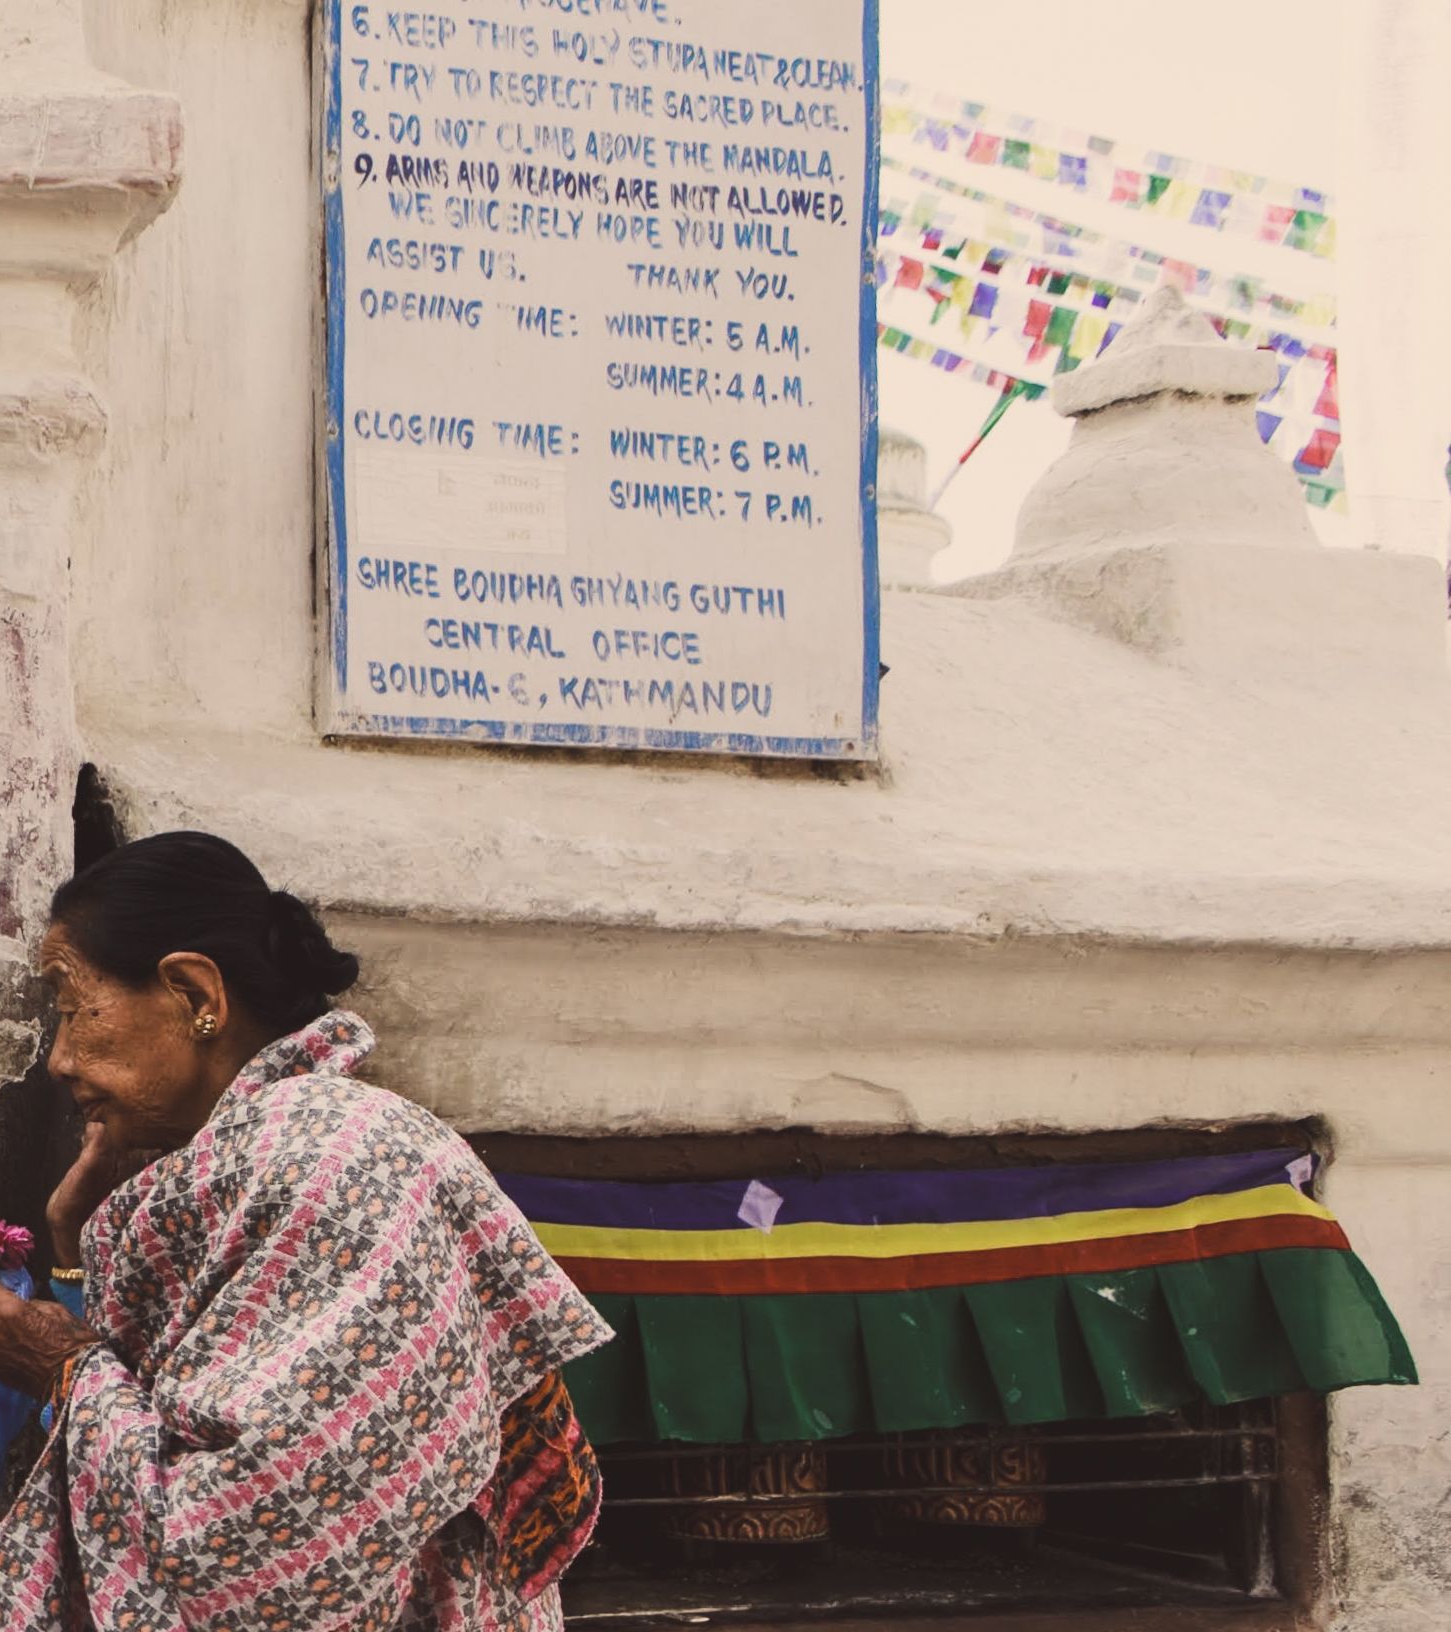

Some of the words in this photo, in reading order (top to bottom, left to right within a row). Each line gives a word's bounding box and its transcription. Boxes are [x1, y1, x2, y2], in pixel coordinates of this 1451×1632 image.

[352, 6, 380, 40] 6.
[387, 11, 456, 48] KEEP
[468, 19, 539, 57] THIS
[552, 28, 620, 66] HOLY
[628, 36, 709, 80] STUPA
[352, 58, 380, 92] 7.
[384, 59, 436, 103] TRY
[448, 68, 481, 101] TO
[490, 70, 598, 110] RESPECT
[610, 82, 653, 117] THE
[663, 90, 754, 129] SACRED
[762, 100, 849, 132] PLACE.
[352, 110, 380, 141] 8.
[388, 112, 420, 147] DO
[434, 118, 486, 149] NOT
[497, 121, 576, 161] CLIMB
[585, 130, 656, 168] ABOVE
[665, 140, 714, 173] THE
[722, 143, 845, 185] MANDALA.
[354, 153, 377, 190] 9.
[386, 153, 449, 189] ARMS
[458, 159, 499, 194] AND
[507, 162, 609, 205] WEAPONS
[615, 177, 659, 210] ARE
[670, 182, 720, 216] NOT
[728, 185, 846, 226] ALLOWED.
[388, 186, 434, 225] WE
[445, 196, 583, 240] SINCERELY
[597, 212, 662, 249] HOPE
[674, 211, 724, 250] YOU
[734, 219, 798, 257] WILL
[367, 237, 463, 273] ASSIST
[627, 264, 720, 300] THANK
[735, 266, 795, 301] YOU.
[360, 288, 483, 330] OPENING
[605, 312, 713, 352] WINTER:
[727, 321, 744, 351] 5
[755, 323, 811, 361] A.M.
[606, 362, 720, 405] SUMMER:
[726, 373, 745, 403] 4
[753, 374, 813, 407] A.M.
[354, 409, 474, 450] CLOSING
[492, 420, 579, 459] TIME:
[610, 427, 719, 473] WINTER:
[730, 439, 750, 472] 6
[763, 440, 819, 476] P.M.
[610, 479, 725, 520] SUMMER:
[734, 491, 751, 521] 7
[766, 494, 822, 529] P.M.
[356, 556, 440, 598] SHREE
[453, 567, 564, 609] BOUDHA
[571, 573, 680, 612] GHYANG
[690, 584, 785, 620] GUTHI
[424, 617, 566, 659] CENTRAL
[592, 629, 702, 665] OFFICE
[558, 677, 773, 718] KATHMANDU
